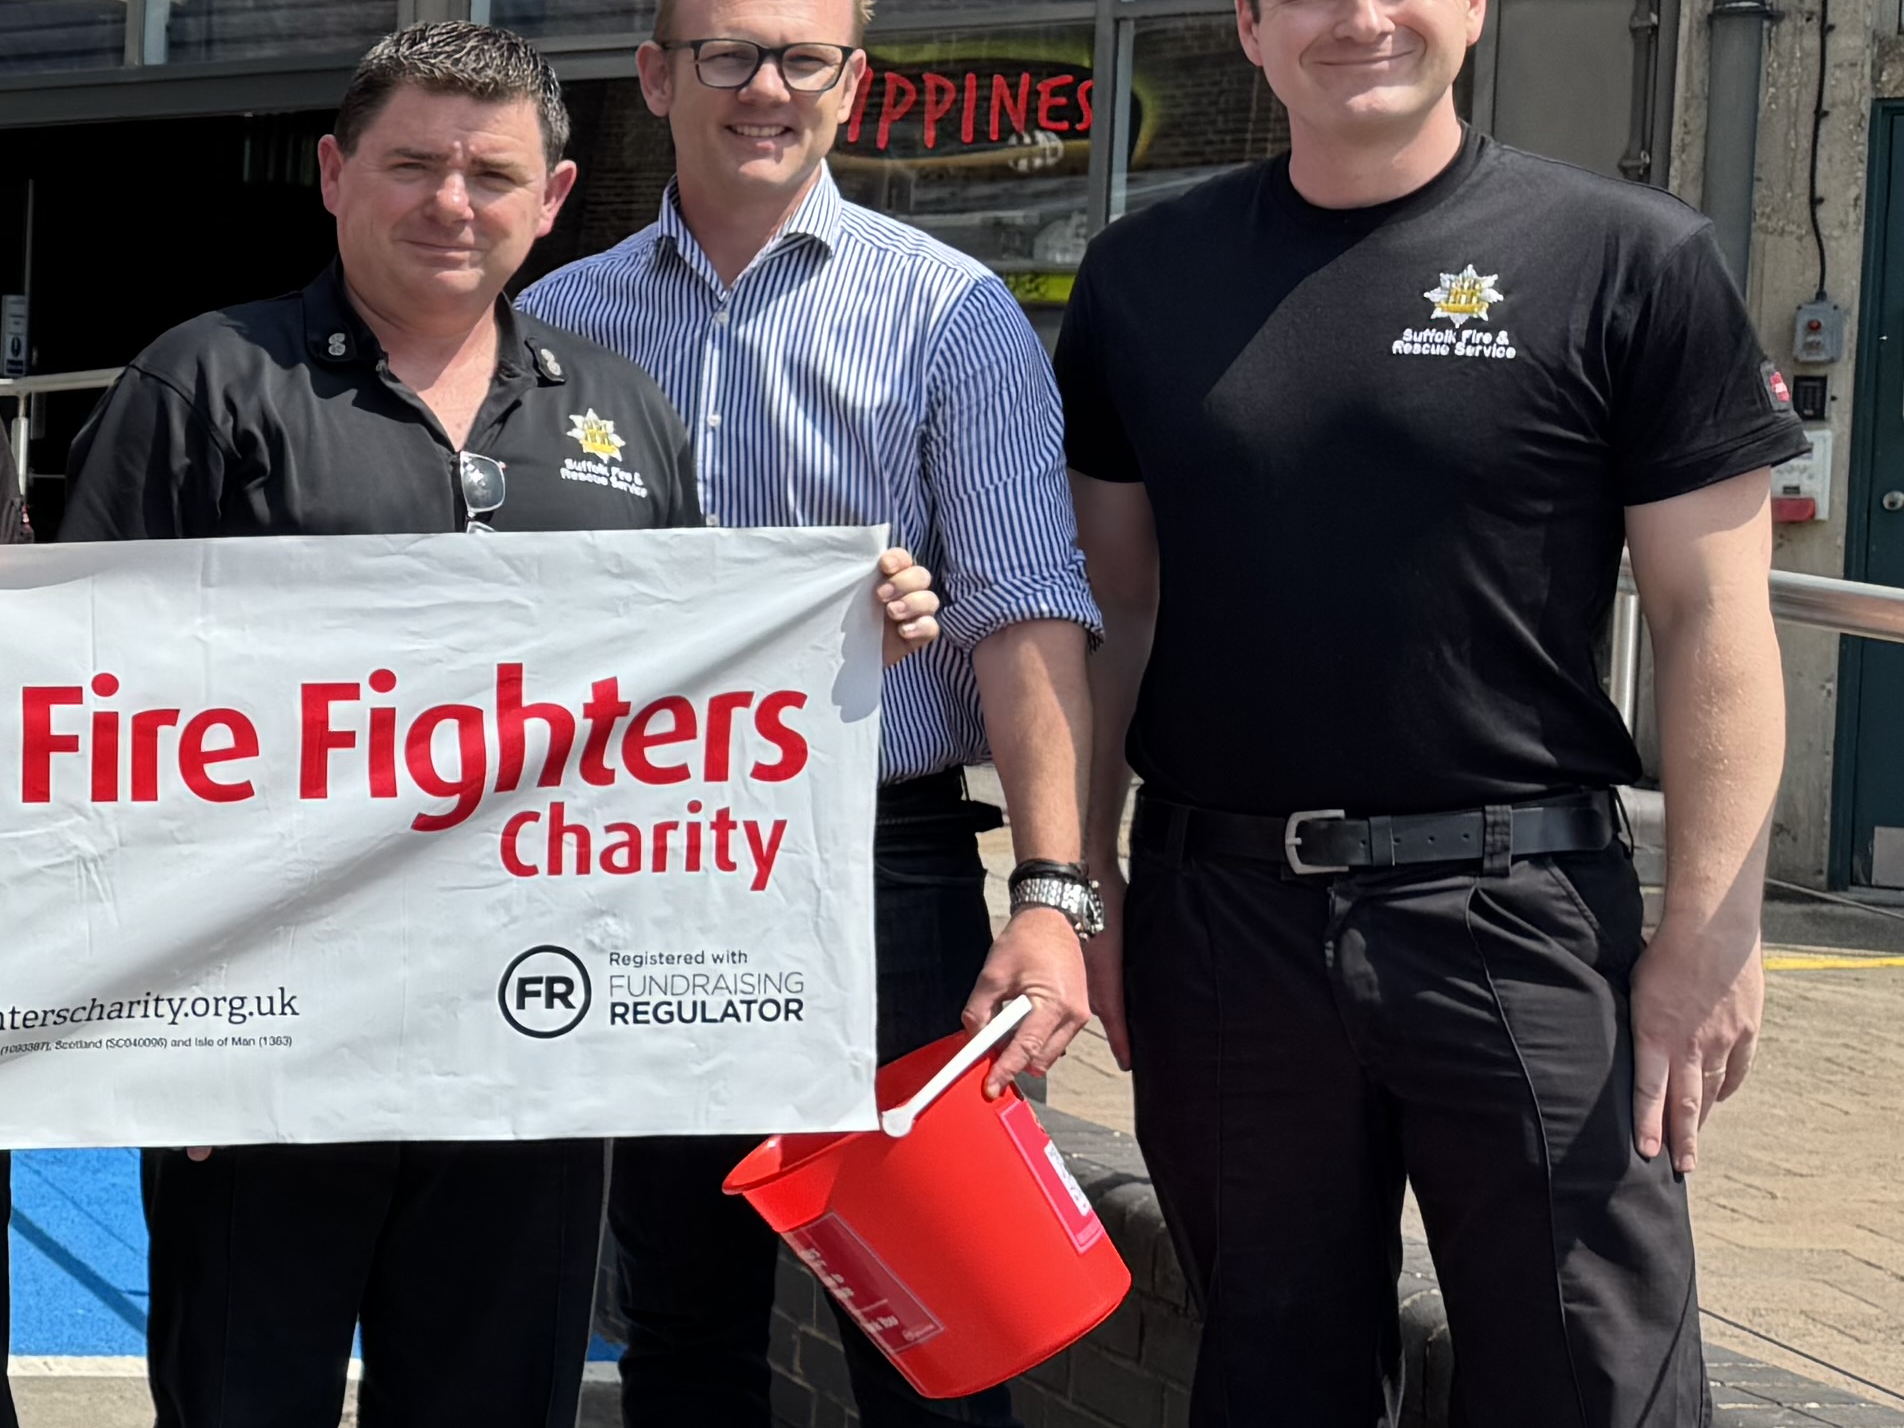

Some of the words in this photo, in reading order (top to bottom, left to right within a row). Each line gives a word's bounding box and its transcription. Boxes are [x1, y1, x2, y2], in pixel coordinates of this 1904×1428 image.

[1403, 328, 1456, 343] Suffolk
[1462, 329, 1492, 345] Fire
[1496, 330, 1509, 345] &
[1392, 340, 1449, 356] Rescue
[1454, 342, 1516, 359] Service
[564, 458, 609, 477] Suffolk
[21, 672, 260, 803] Fire
[299, 662, 809, 832] Fighters
[500, 801, 787, 891] Charity
[609, 952, 705, 968] Registered
[712, 950, 748, 965] with
[516, 976, 576, 1010] FR
[609, 972, 804, 998] FUNDRAISING
[610, 998, 804, 1025] REGULATOR
[55, 1038, 103, 1050] Scotland
[171, 1037, 192, 1048] and
[195, 1037, 214, 1047] Isle
[217, 1036, 228, 1047] of
[231, 1036, 255, 1047] Man
